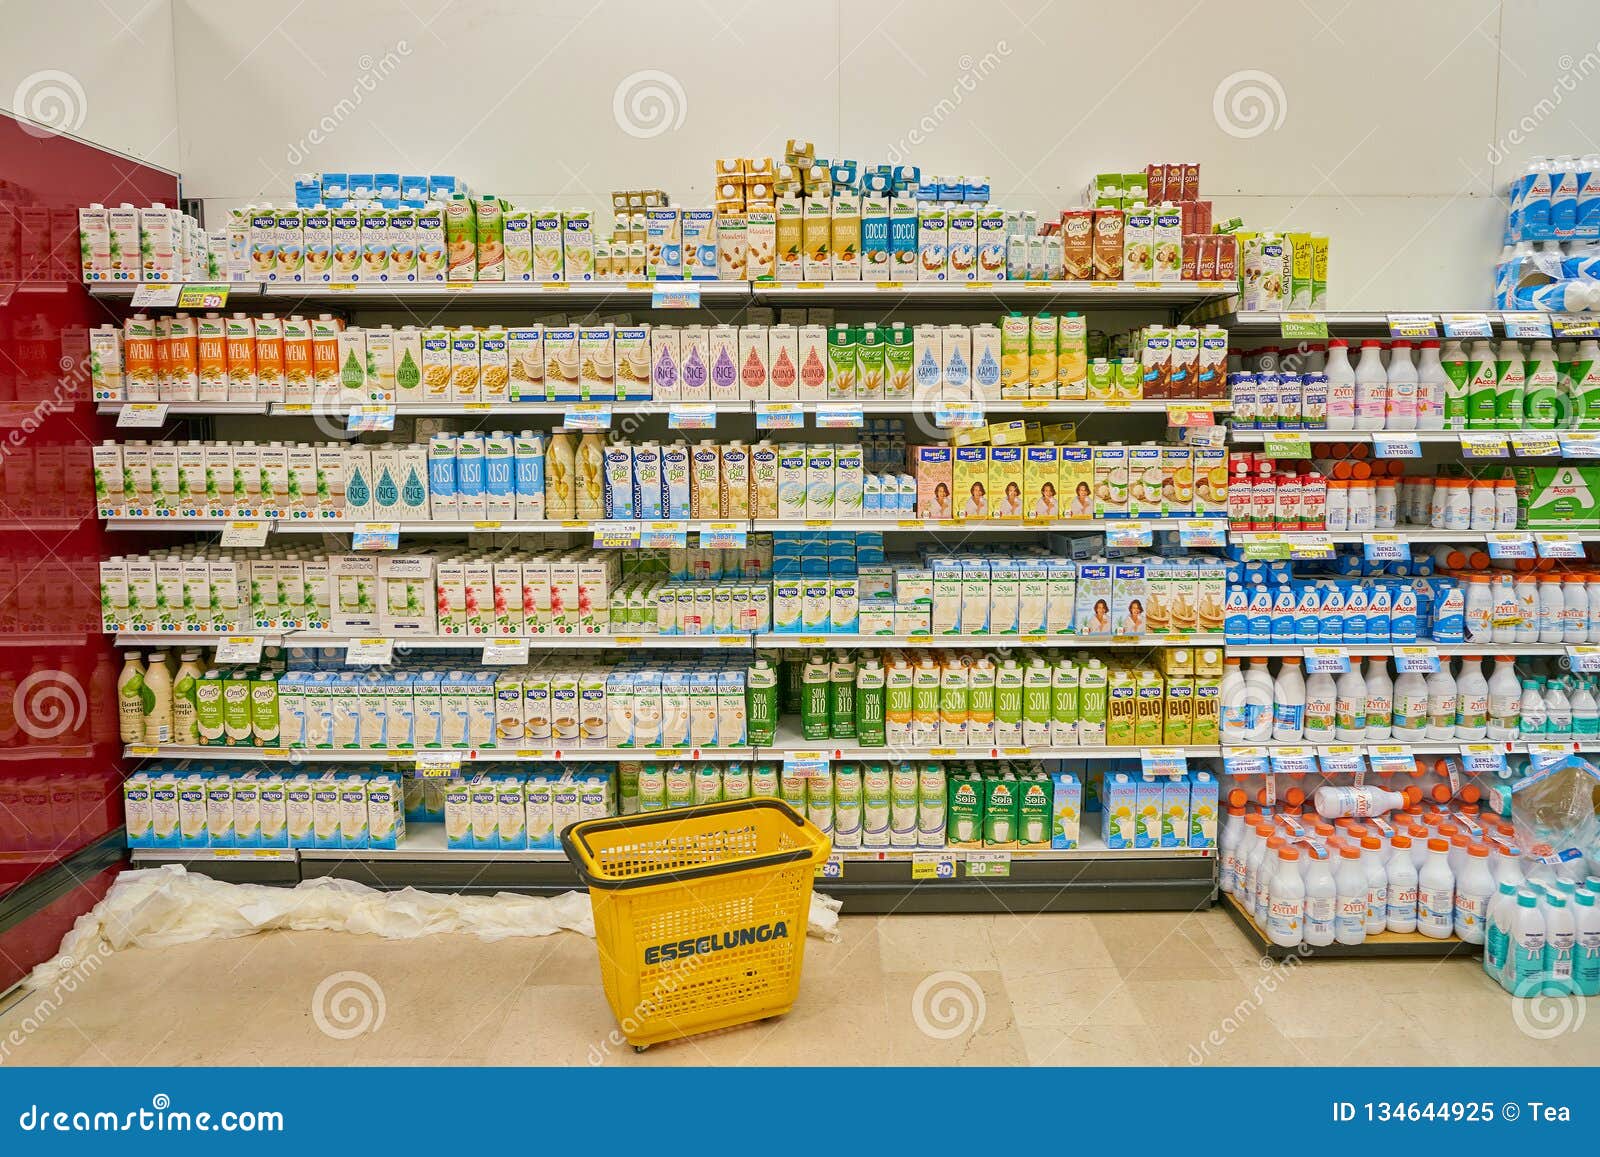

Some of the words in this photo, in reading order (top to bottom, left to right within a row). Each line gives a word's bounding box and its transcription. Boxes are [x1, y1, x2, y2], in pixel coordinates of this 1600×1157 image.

[254, 217, 273, 227] alpro
[308, 217, 327, 228] alpro
[366, 218, 385, 228] alpro
[420, 218, 440, 228] alpro
[537, 219, 557, 229] alpro
[923, 219, 943, 229] alpro
[982, 219, 1002, 229] alpro
[1159, 216, 1178, 226] alpro
[865, 224, 887, 239] COCCO
[893, 224, 915, 239] COCCO
[1149, 340, 1168, 348] alpro
[130, 344, 153, 359] AVENA
[399, 370, 418, 380] AVENA
[686, 367, 703, 378] RICE
[716, 367, 732, 378] RICE
[742, 369, 765, 378] QUINOA
[801, 368, 824, 378] QUINOA
[918, 367, 938, 376] KAMUT
[947, 367, 967, 376] KAMUT
[977, 367, 998, 376] KAMUT
[379, 489, 394, 499] RICE
[406, 489, 421, 499] RICE
[839, 687, 851, 698] SOIA
[753, 693, 766, 704] SOIA
[866, 694, 879, 704] SOIA
[918, 692, 938, 709] SOIA
[946, 692, 966, 709] SOIA
[1000, 693, 1020, 711] SOIA
[1029, 692, 1049, 710] SOIA
[1084, 692, 1104, 710] SOIA
[500, 703, 518, 711] SOYA
[556, 702, 574, 710] SOYA
[812, 700, 825, 713] BIO
[839, 699, 852, 712] BIO
[1112, 701, 1133, 716] BIO
[1140, 700, 1160, 716] BIO
[1170, 700, 1190, 715] BIO
[1197, 700, 1218, 715] BIO
[753, 707, 766, 719] BIO
[866, 707, 879, 720] BIO
[955, 795, 976, 804] Soia
[1025, 795, 1046, 804] Soia
[936, 864, 952, 875] 30
[971, 863, 986, 873] 20
[644, 921, 788, 965] ESSELUNGA
